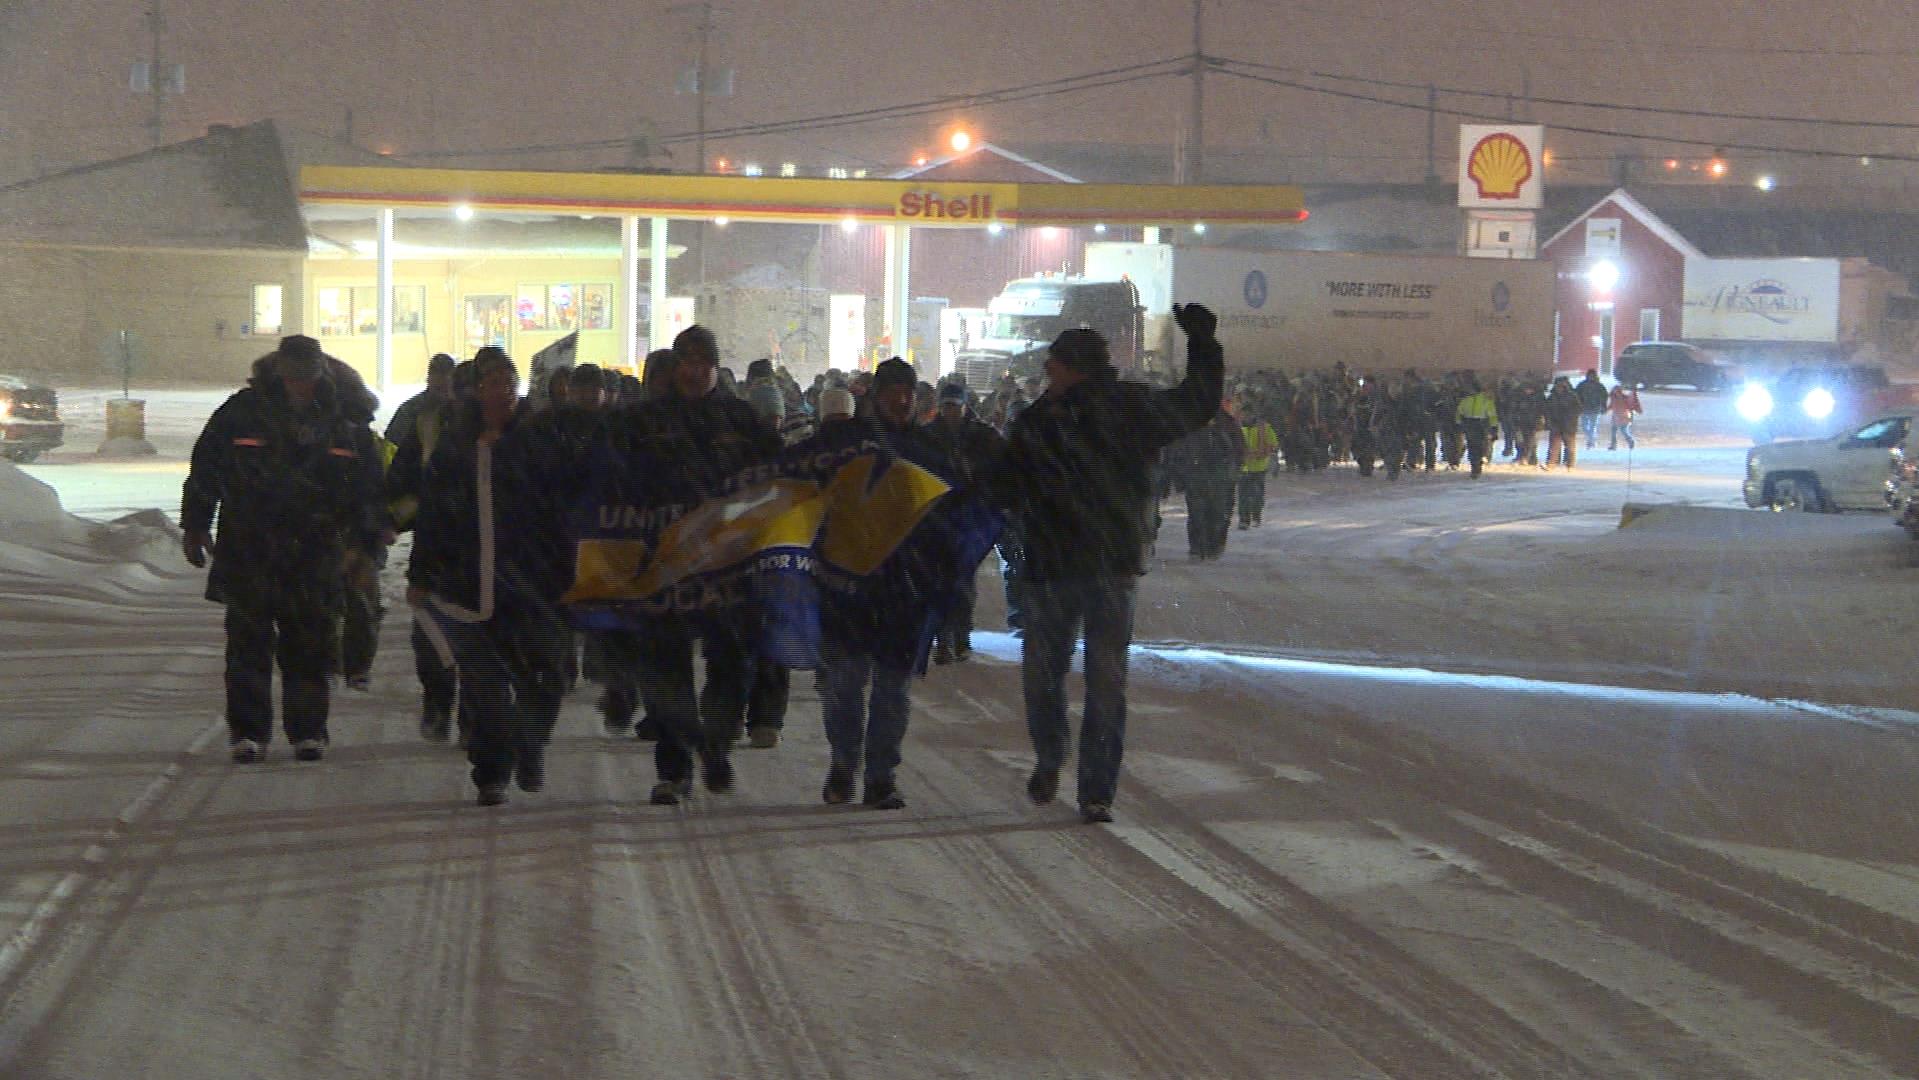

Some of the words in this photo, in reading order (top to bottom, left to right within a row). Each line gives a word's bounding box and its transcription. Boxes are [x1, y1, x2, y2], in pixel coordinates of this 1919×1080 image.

[900, 191, 991, 218] Shell
[1366, 282, 1401, 298] WITH
[599, 504, 686, 529] UNITE
